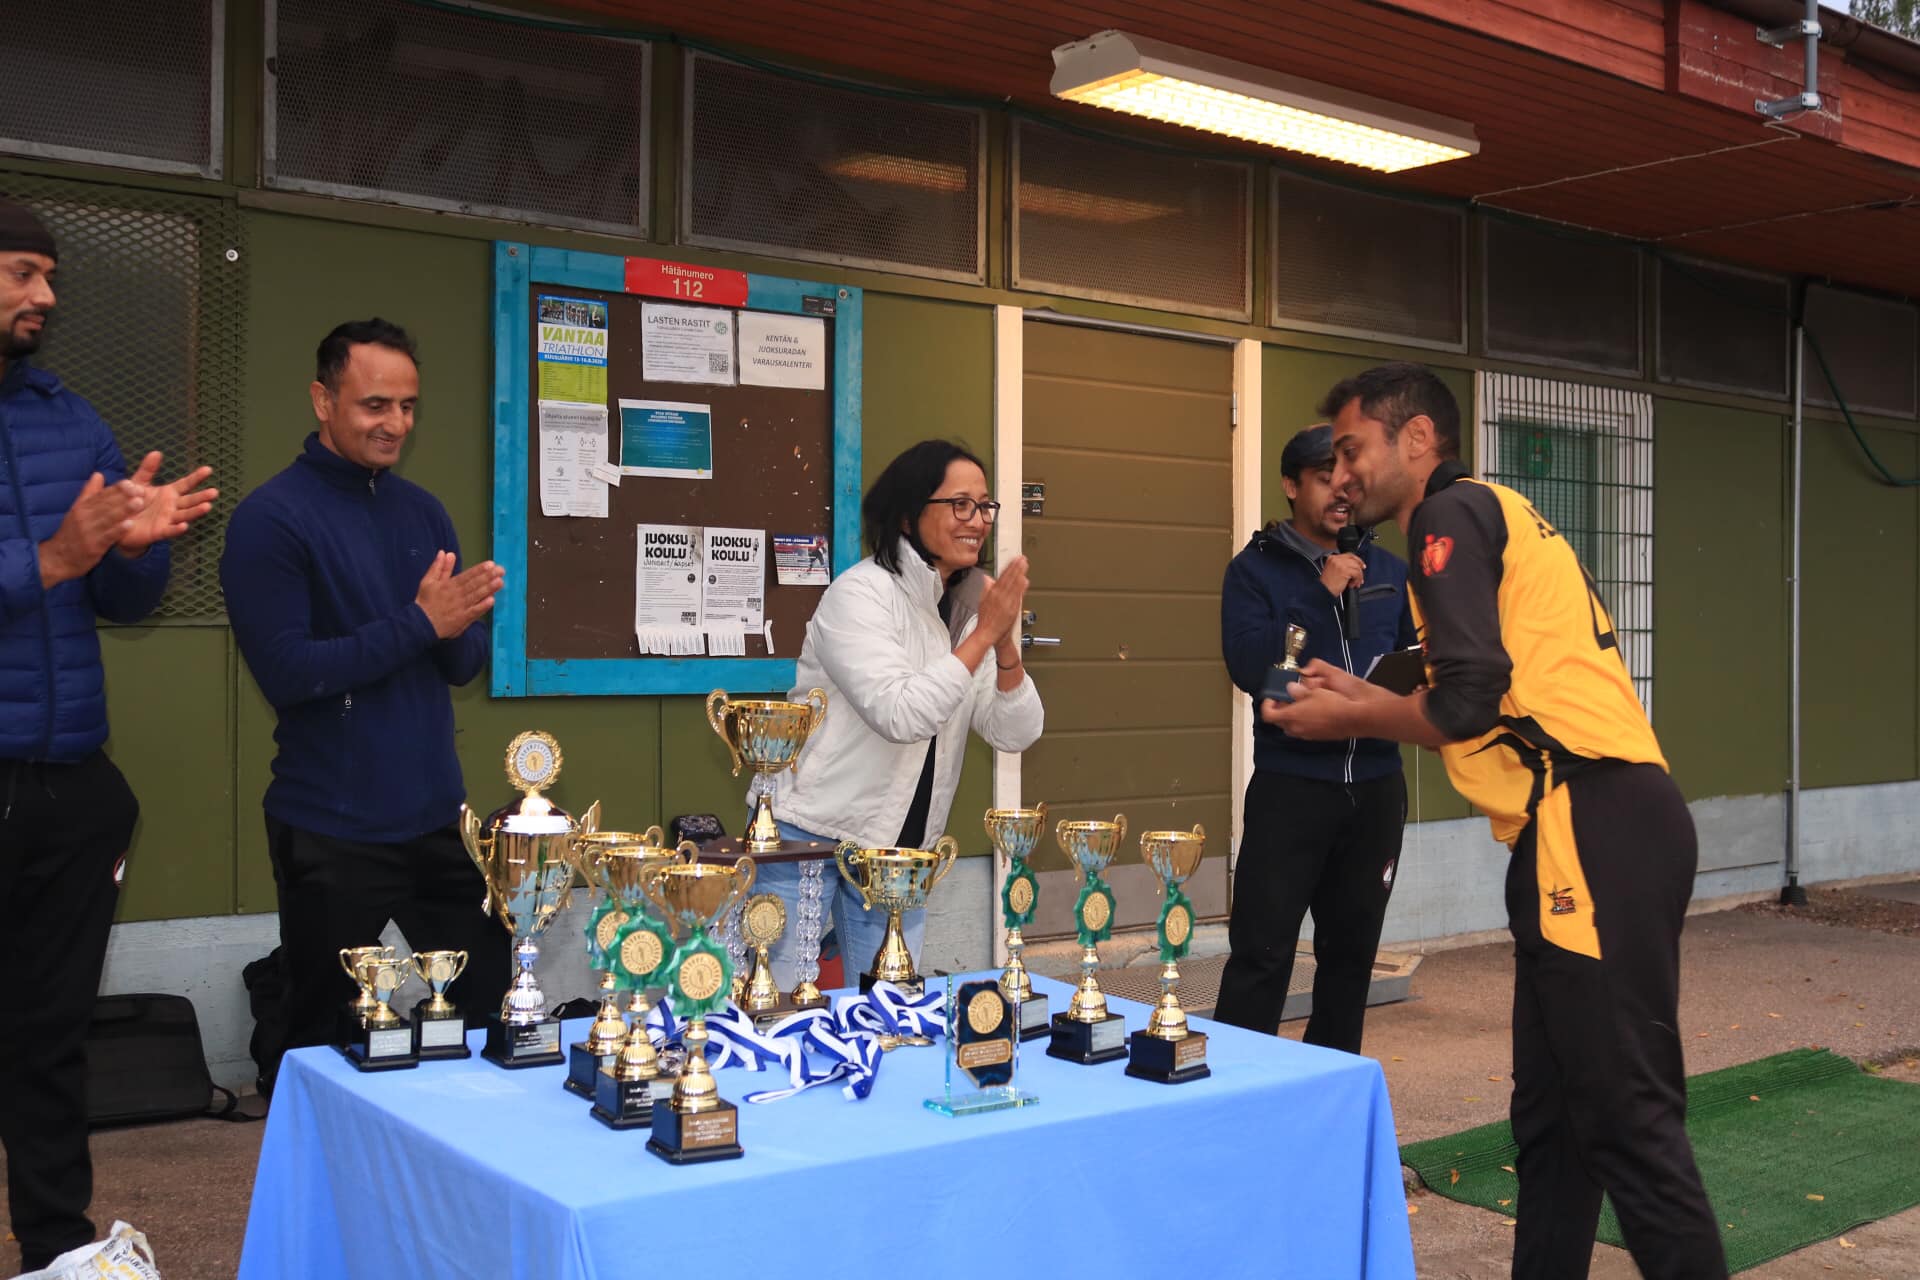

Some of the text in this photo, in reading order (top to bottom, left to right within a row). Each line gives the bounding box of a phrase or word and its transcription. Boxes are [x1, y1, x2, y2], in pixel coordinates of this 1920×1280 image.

[672, 278, 703, 298] 112
[648, 315, 680, 325] LASTEN
[681, 318, 711, 328] RASTIT
[543, 326, 605, 347] VANTAA
[765, 334, 793, 344] KENTÄN
[543, 342, 604, 357] TRIATHLON
[758, 345, 807, 356] JUOKSURADAN
[752, 357, 813, 369] VARAUSKALENTERI
[645, 533, 688, 545] JUOKSU
[711, 536, 752, 548] JUOKSU
[645, 547, 687, 559] KOULU
[711, 549, 750, 562] KOULU
